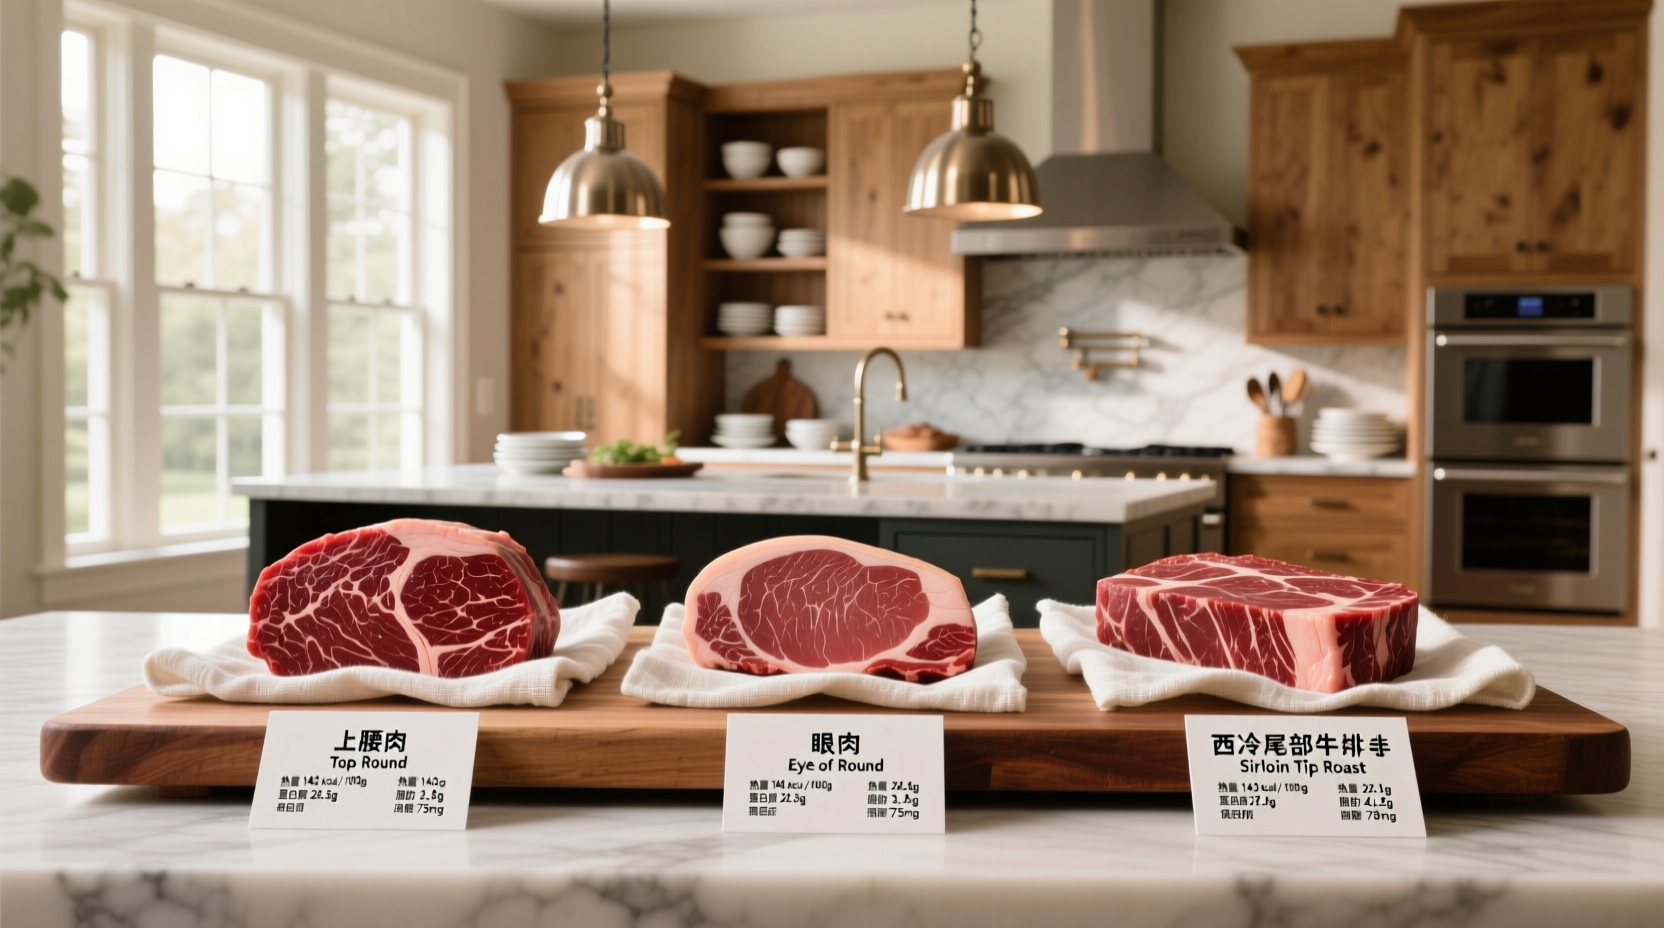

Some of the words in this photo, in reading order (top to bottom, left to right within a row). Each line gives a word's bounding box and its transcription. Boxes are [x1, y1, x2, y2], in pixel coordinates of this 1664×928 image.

[333, 729, 407, 753] 上腰肉
[811, 731, 860, 755] 眼肉
[330, 755, 357, 772] Top
[361, 755, 408, 769] Round
[788, 758, 815, 775] Eye
[818, 758, 834, 772] of
[838, 758, 884, 772] Round
[1240, 759, 1290, 774] Sirloin
[1293, 759, 1319, 778] Tip
[1323, 760, 1367, 774] Roast
